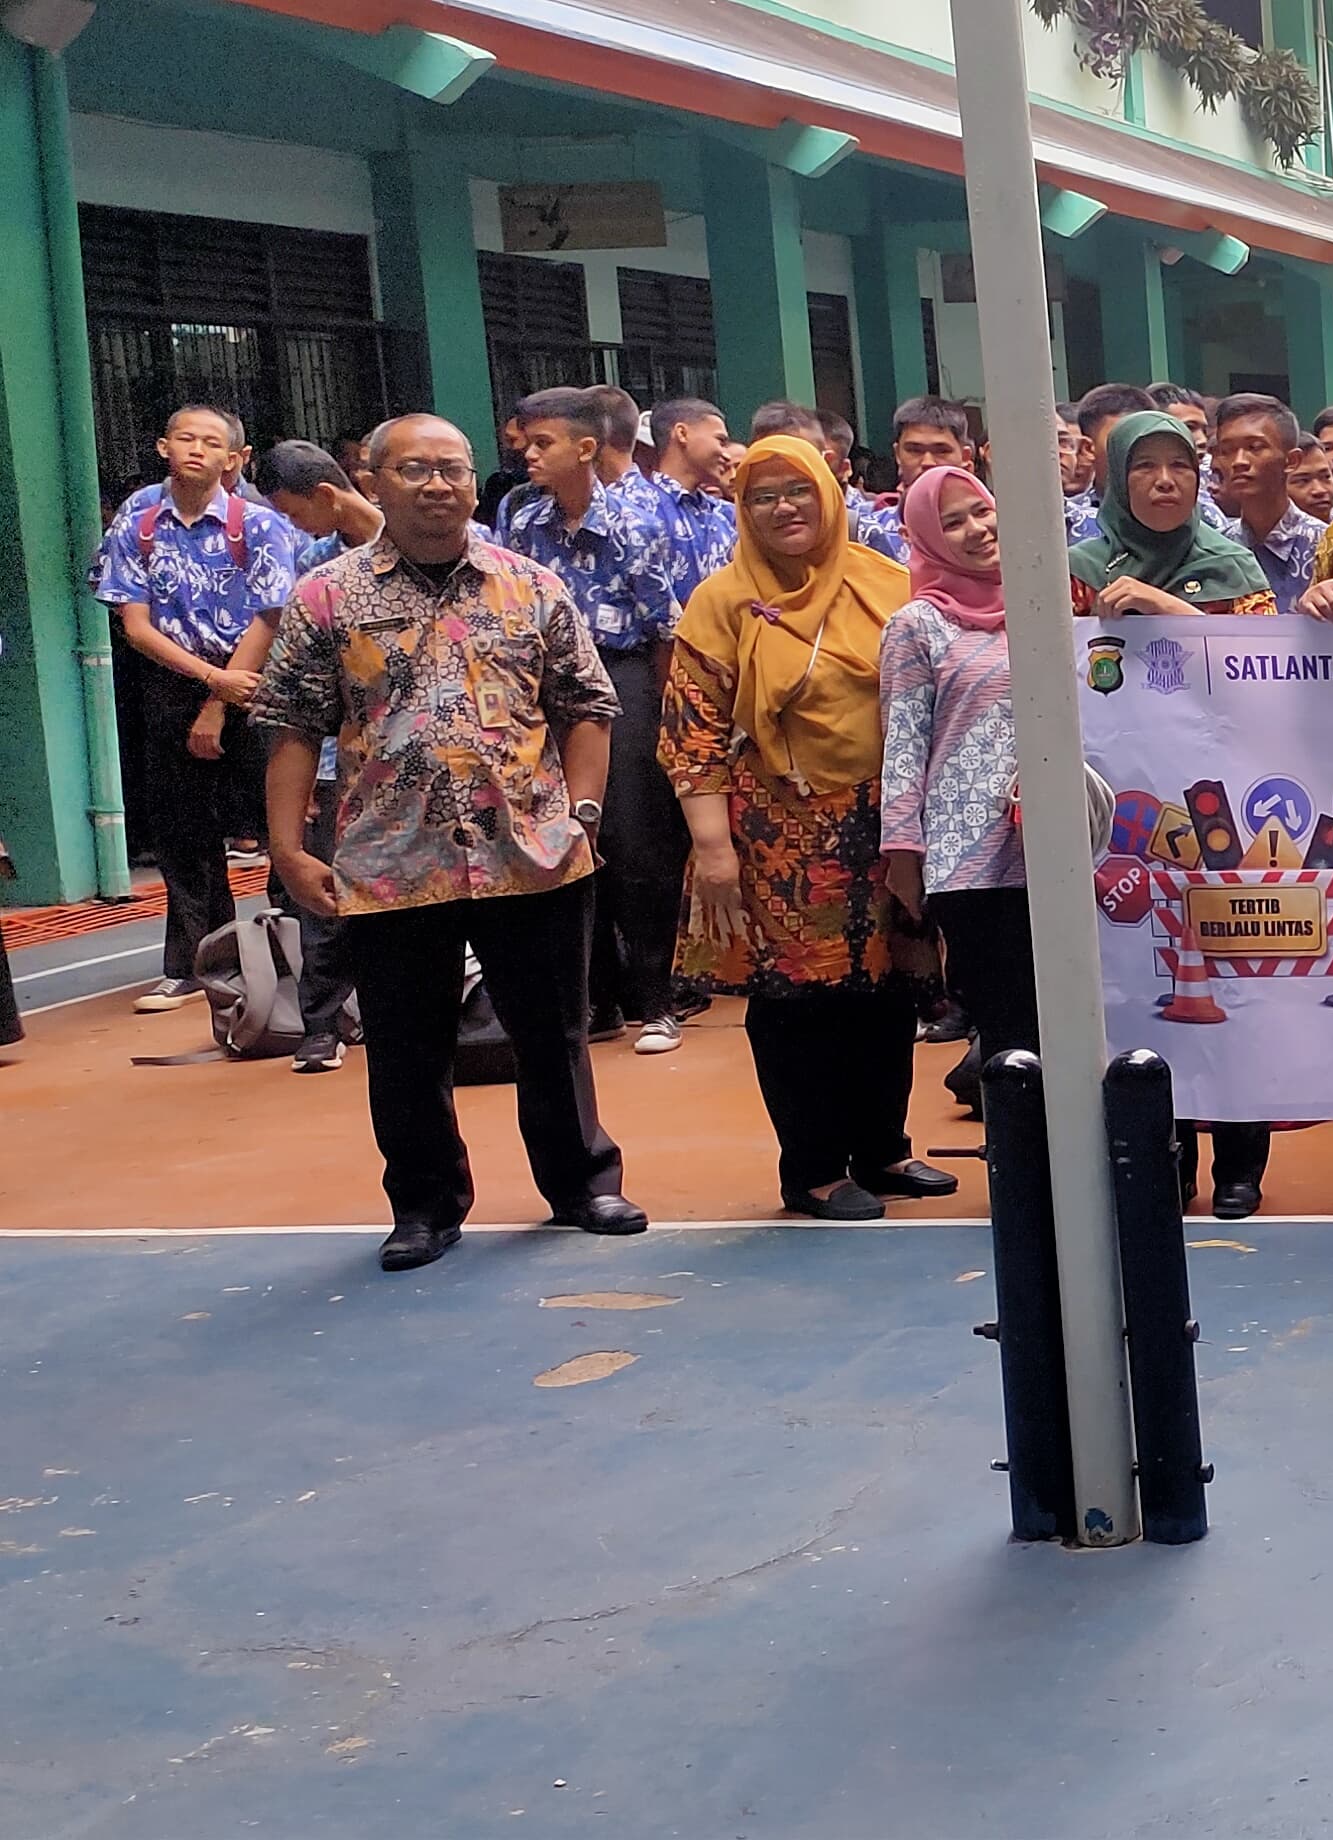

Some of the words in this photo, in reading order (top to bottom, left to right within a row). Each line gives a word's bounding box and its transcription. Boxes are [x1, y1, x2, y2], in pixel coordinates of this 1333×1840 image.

[1102, 867, 1141, 914] STOP
[1229, 899, 1281, 914] TERTIB
[1199, 919, 1261, 937] BERLALU
[1264, 919, 1314, 937] LINTAS
